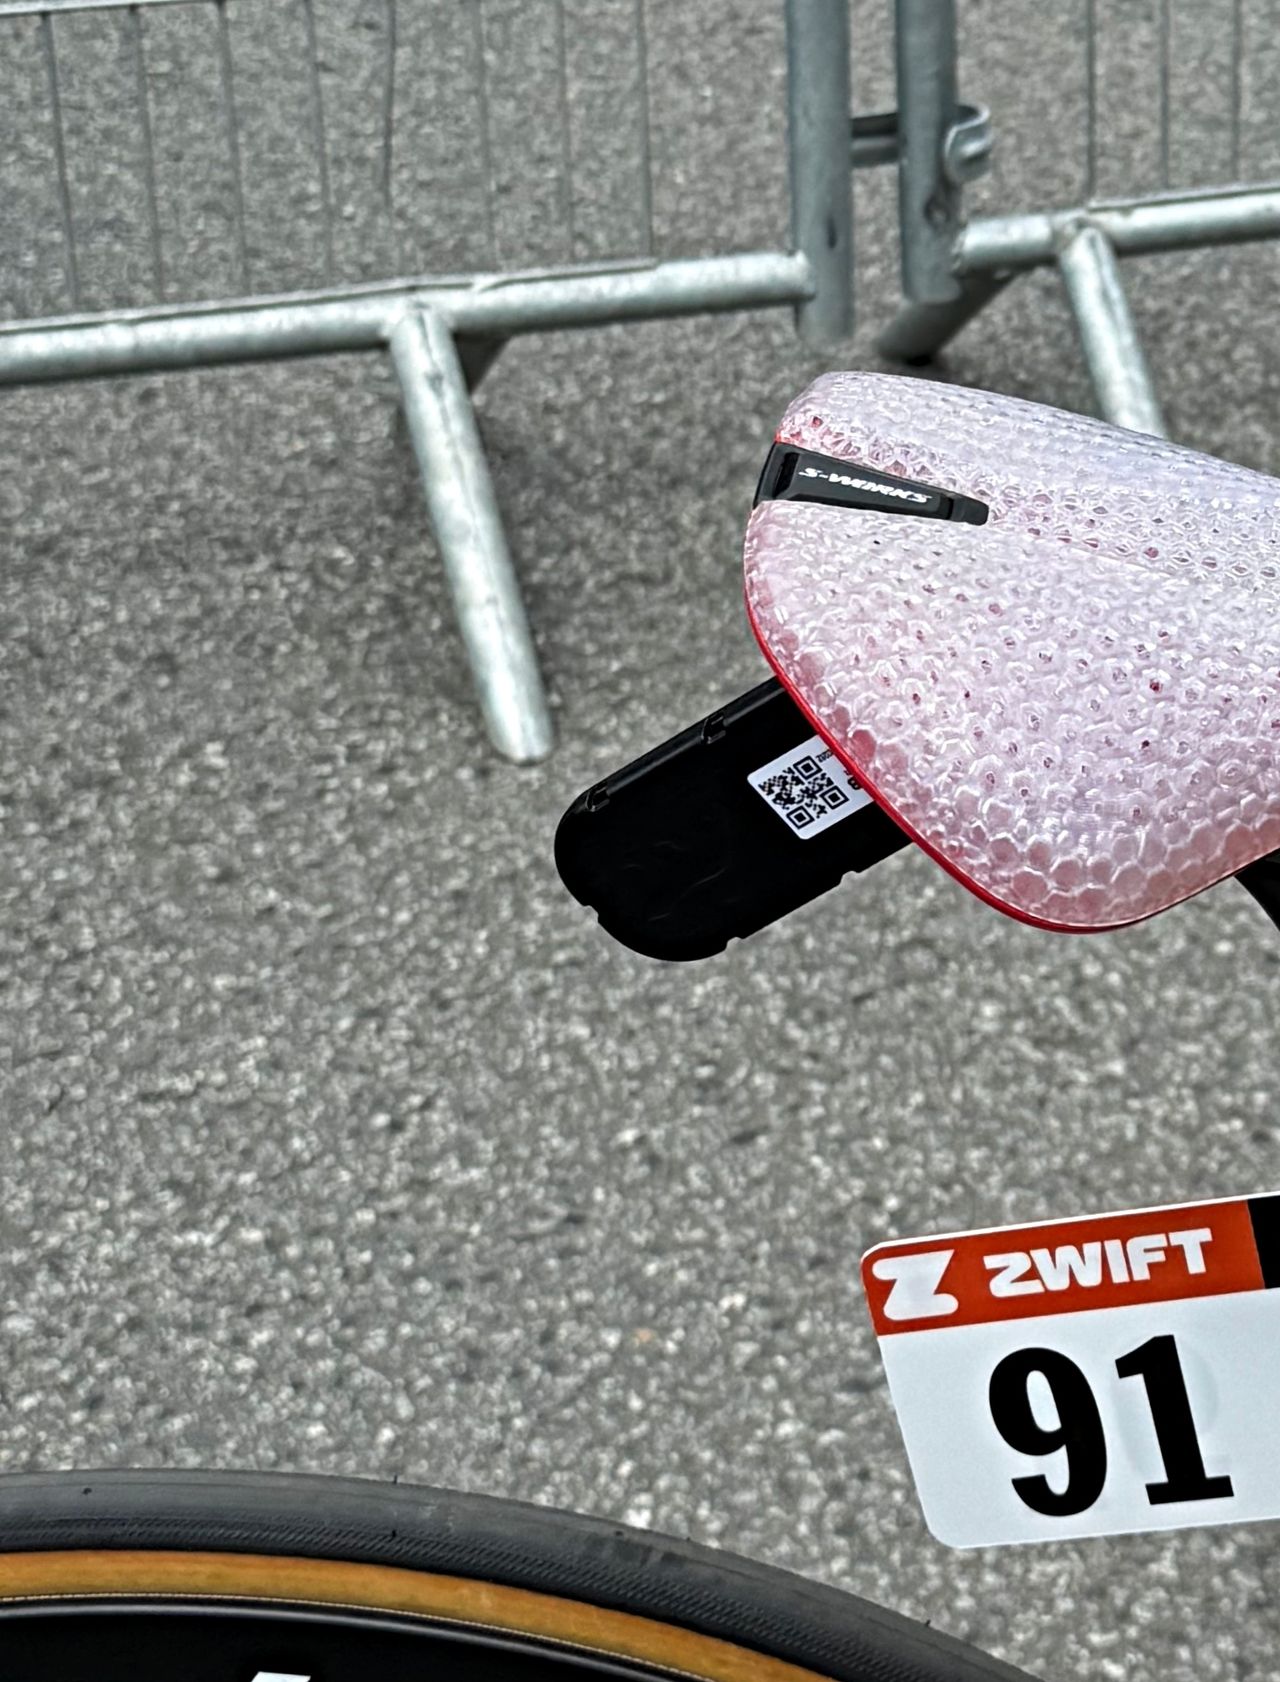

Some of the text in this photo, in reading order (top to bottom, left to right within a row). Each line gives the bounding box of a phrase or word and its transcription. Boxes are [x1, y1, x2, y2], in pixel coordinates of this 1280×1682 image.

[798, 467, 933, 504] S-WORKS
[983, 1228, 1213, 1299] ZWIFT
[988, 1334, 1235, 1517] 91
